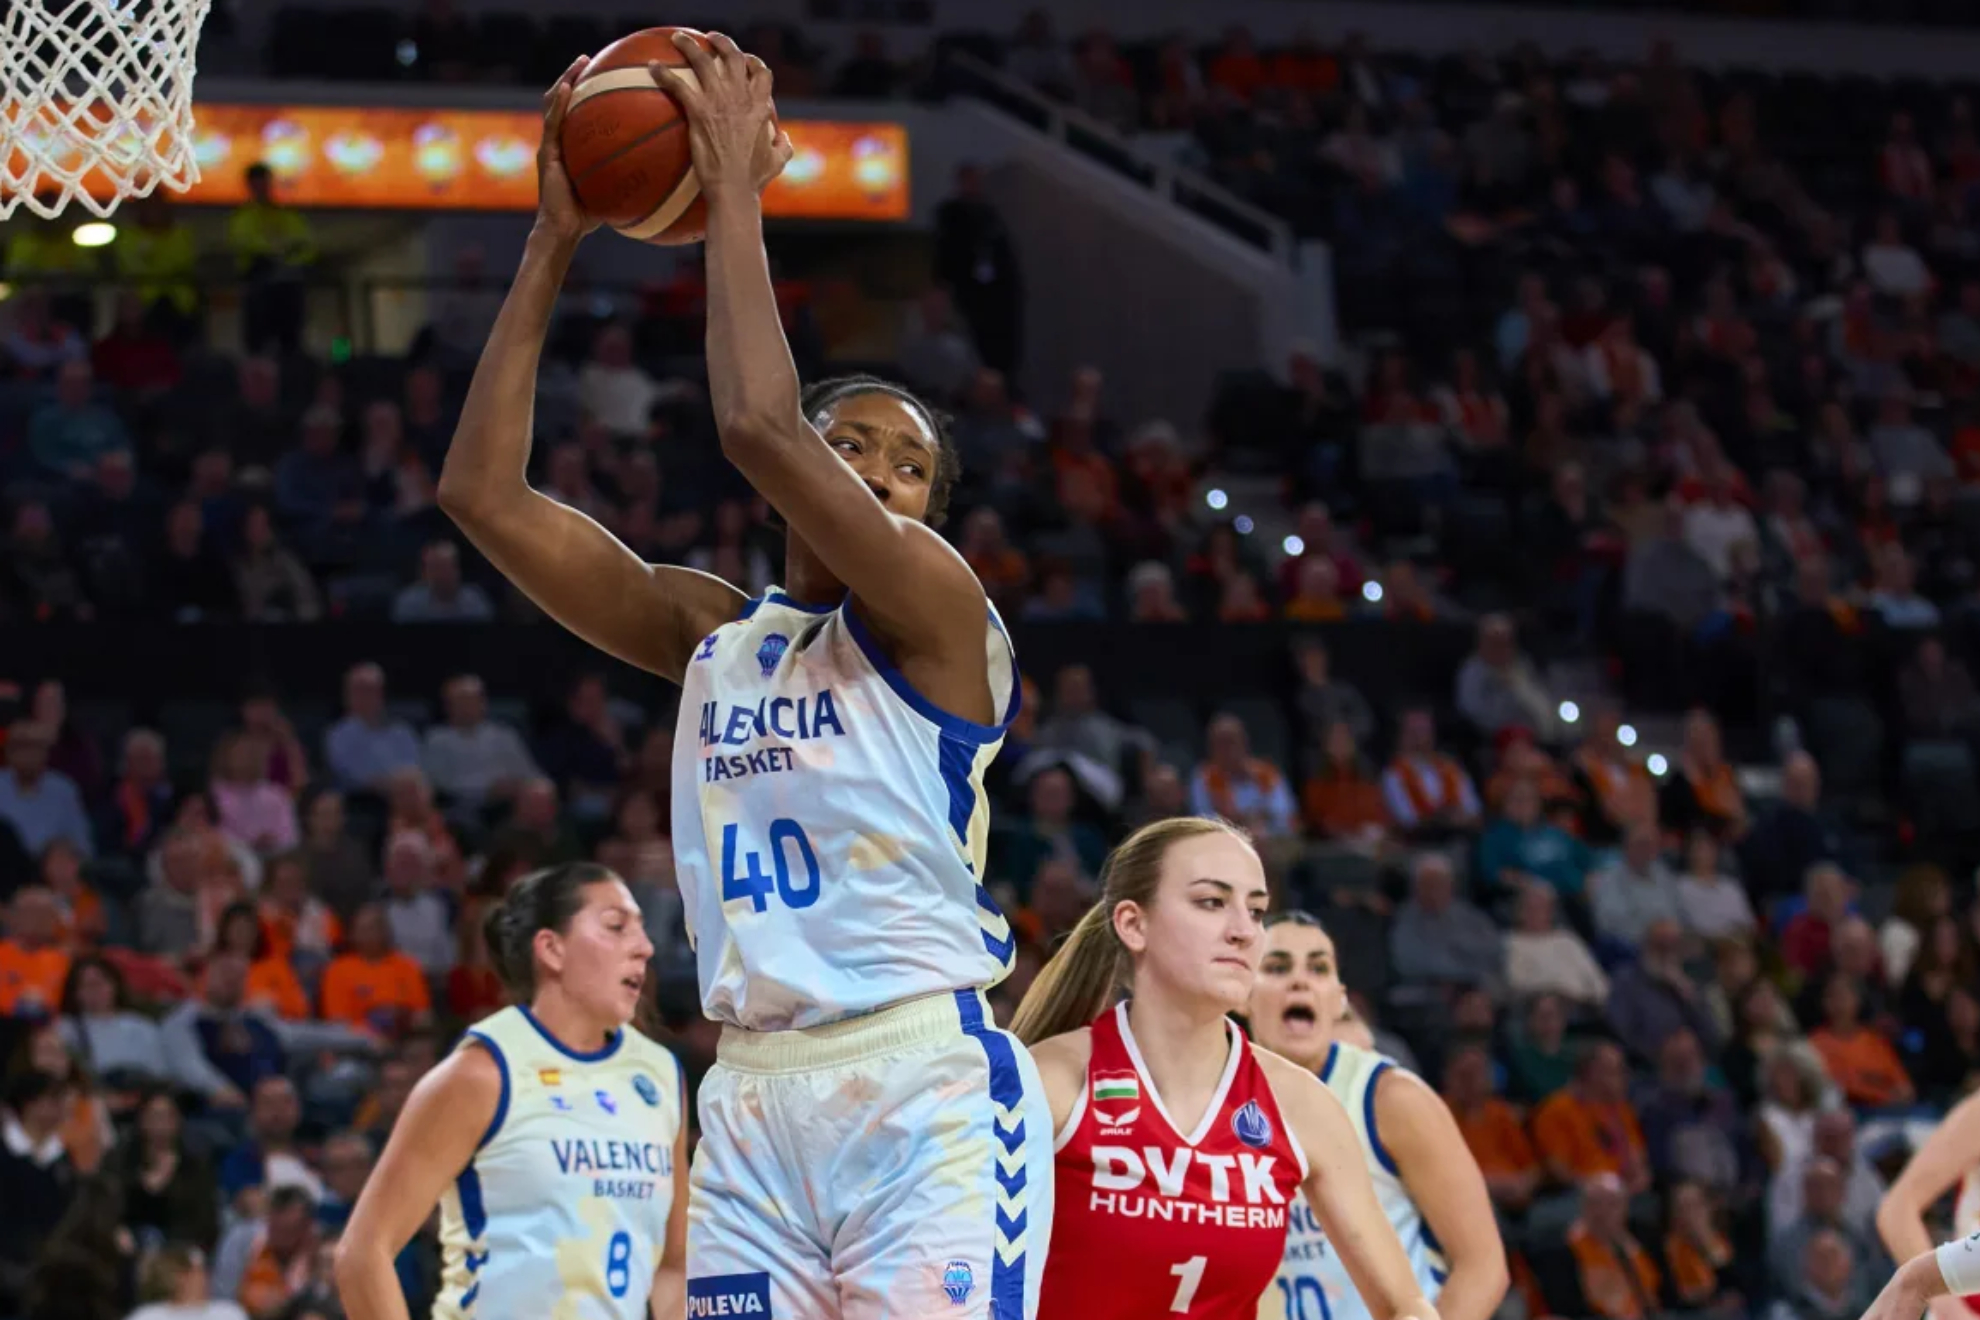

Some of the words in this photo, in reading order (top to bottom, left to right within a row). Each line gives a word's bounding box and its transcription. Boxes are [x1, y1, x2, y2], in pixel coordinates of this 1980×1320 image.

[699, 689, 846, 747] ALENCIA
[722, 818, 820, 913] 40
[594, 1179, 655, 1200] BASKET
[1091, 1145, 1286, 1204] DVTK
[1090, 1191, 1285, 1229] HUNTHERM
[606, 1230, 632, 1298] 8
[1169, 1255, 1208, 1314] 1
[688, 1292, 764, 1320] PULEVA
[1275, 1275, 1334, 1320] 10
